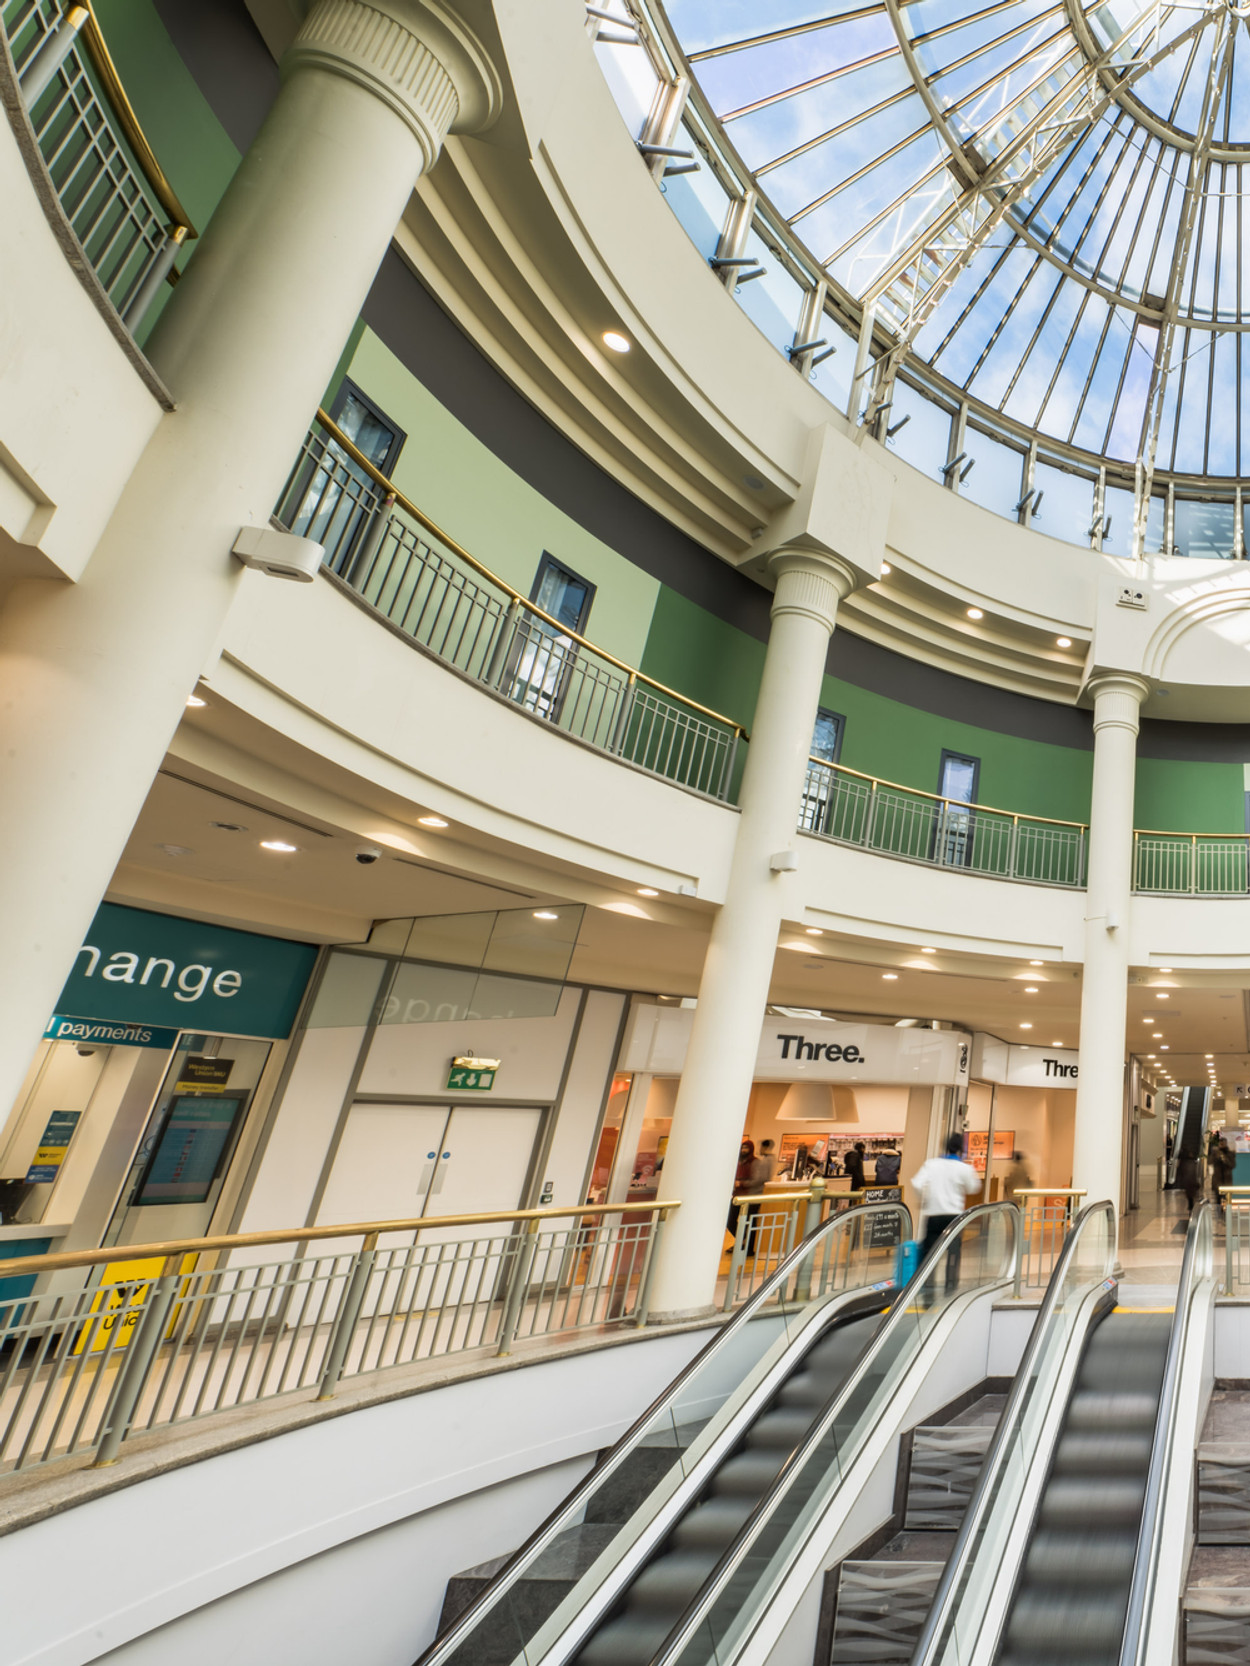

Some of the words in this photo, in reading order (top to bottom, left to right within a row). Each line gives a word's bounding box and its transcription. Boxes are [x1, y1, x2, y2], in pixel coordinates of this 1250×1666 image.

[57, 1021, 153, 1042] payments
[777, 1034, 865, 1063] Three.
[103, 1315, 138, 1330] Uio
